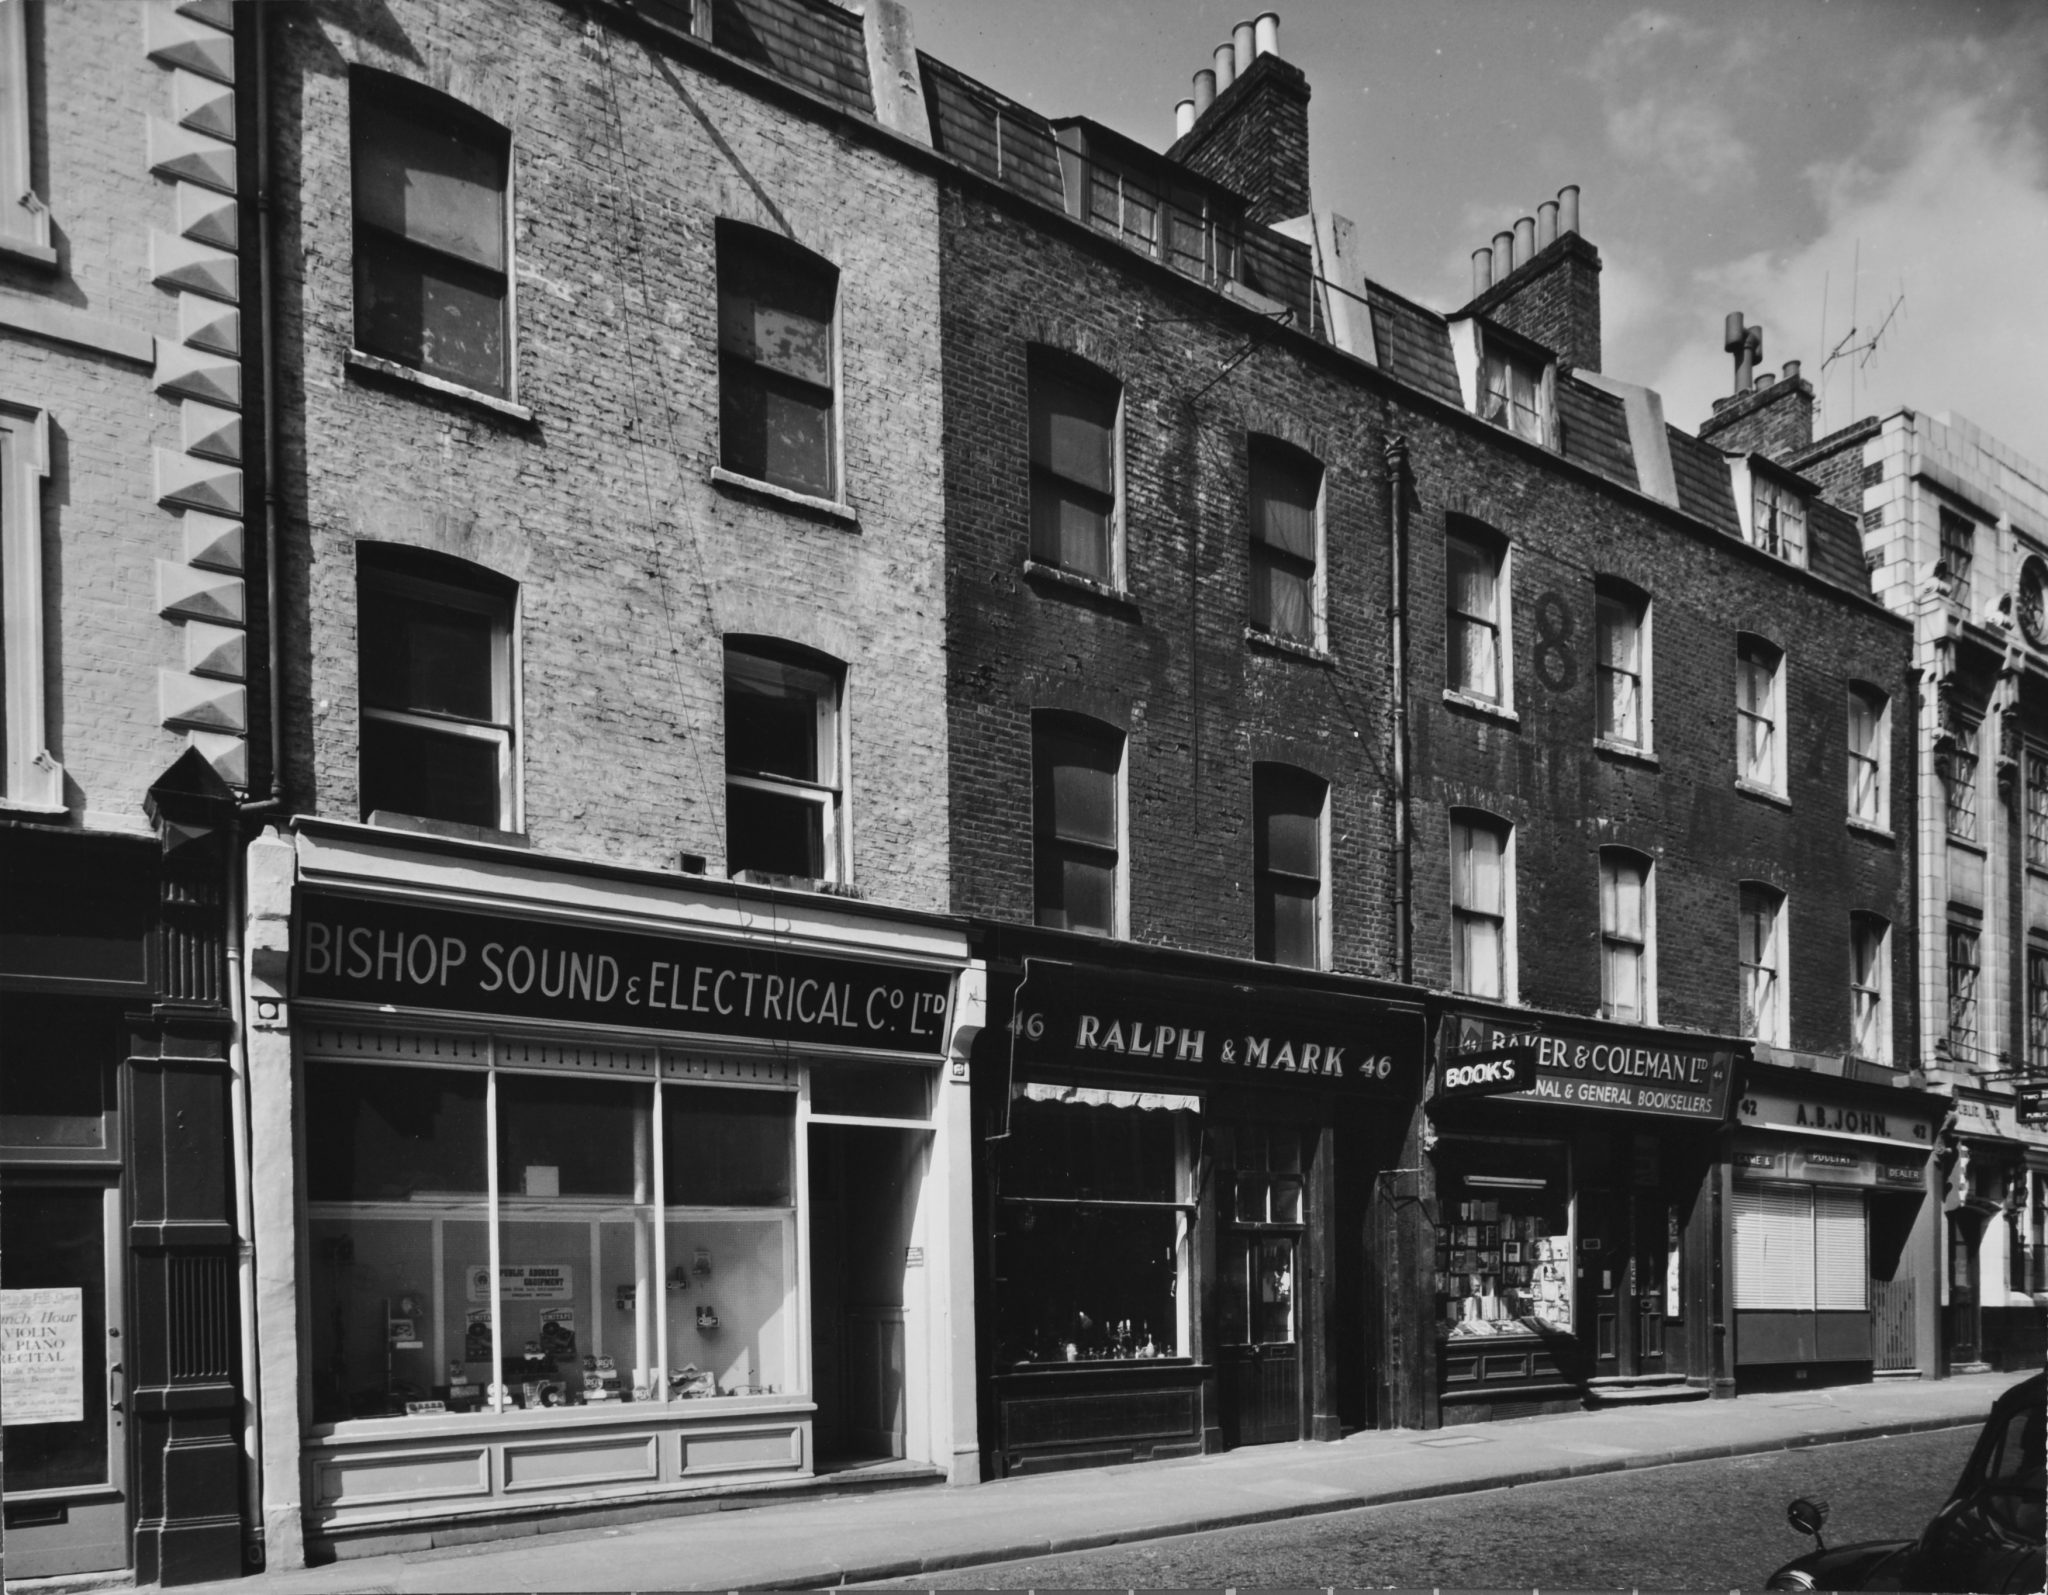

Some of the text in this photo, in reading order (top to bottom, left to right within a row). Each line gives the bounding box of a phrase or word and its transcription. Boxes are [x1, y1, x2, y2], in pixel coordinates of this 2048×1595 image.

[1535, 591, 1577, 692] 8
[305, 922, 467, 986] BISHOP
[480, 942, 619, 1003] SOUND
[649, 961, 858, 1028] ELECTRICAL
[1006, 1012, 1044, 1041] 46
[1075, 1014, 1345, 1077] RALPH & MARK
[1360, 1056, 1392, 1079] 46
[1446, 1060, 1516, 1088] BOOKS
[1574, 1045, 1590, 1069] &
[1592, 1044, 1686, 1081] COLEMAN
[1713, 1070, 1723, 1080] 44
[1564, 1084, 1573, 1098] &
[1578, 1084, 1632, 1105] GENERAL
[1638, 1090, 1712, 1113] BOOKSELLERS
[1741, 1100, 1757, 1116] 42
[1912, 1124, 1926, 1139] 42
[1889, 1167, 1920, 1178] DEALER
[41, 1311, 77, 1323] Hour
[4, 1327, 57, 1338] VIOLIN
[16, 1339, 65, 1351] PIANO
